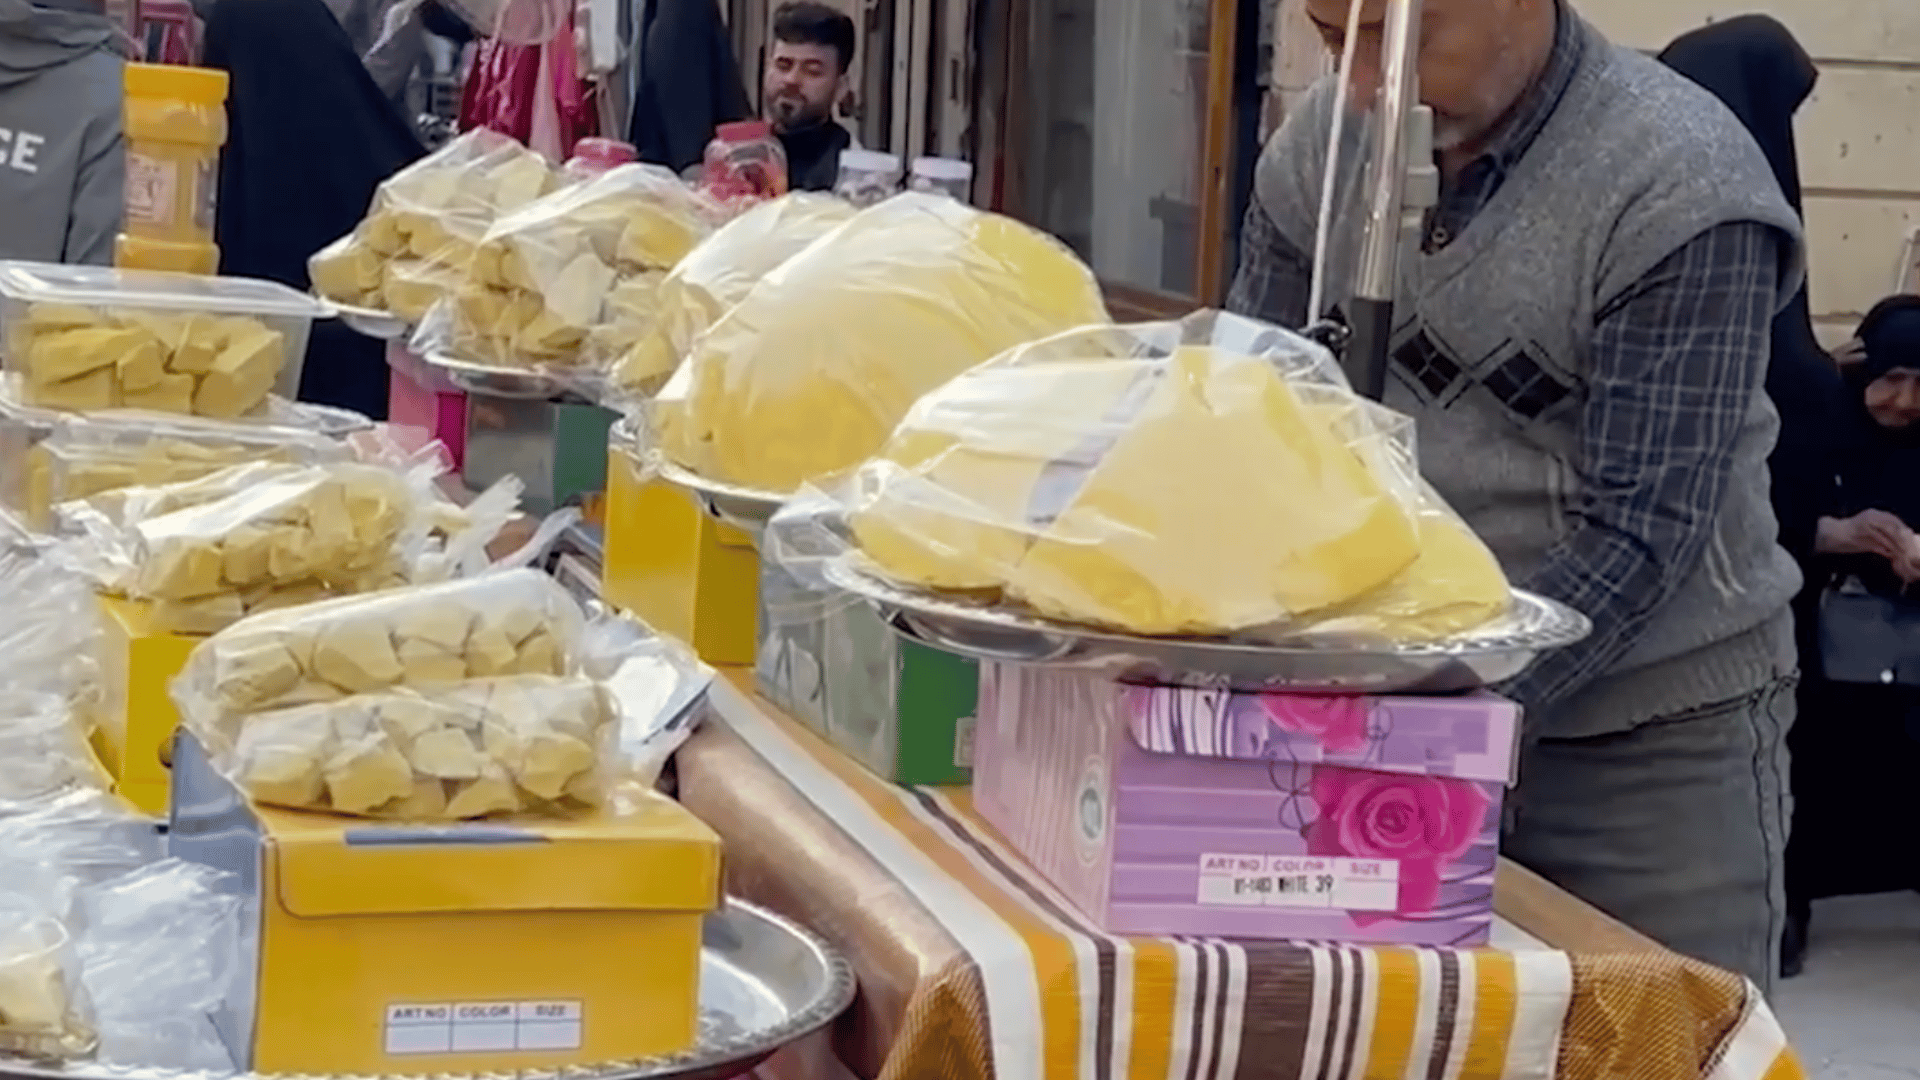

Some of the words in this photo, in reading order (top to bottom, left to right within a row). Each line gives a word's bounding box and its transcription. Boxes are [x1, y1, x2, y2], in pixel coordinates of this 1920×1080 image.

[1206, 857, 1235, 870] ART
[1238, 859, 1260, 871] NO
[1351, 862, 1382, 876] SIZE
[1315, 874, 1334, 893] 39
[393, 1007, 422, 1019] ART
[425, 1007, 446, 1018] NO
[458, 1005, 511, 1018] COLOR
[535, 1004, 566, 1016] SIZE
